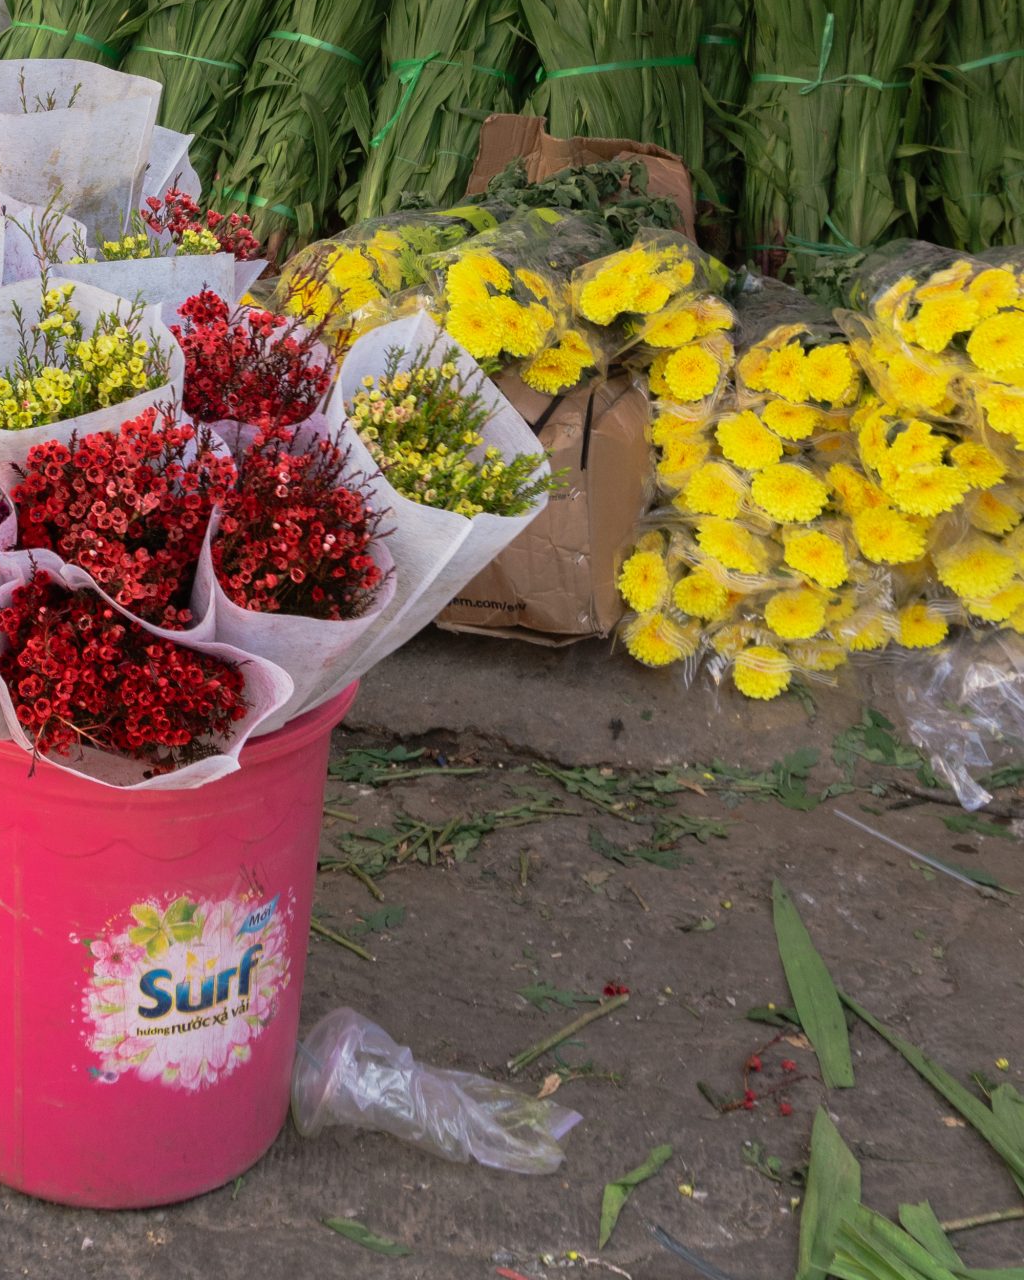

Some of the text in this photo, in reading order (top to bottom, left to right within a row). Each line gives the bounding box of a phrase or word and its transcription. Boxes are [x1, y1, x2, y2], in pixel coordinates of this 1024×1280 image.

[248, 904, 272, 927] Mới
[137, 943, 264, 1020] Surf
[171, 1011, 210, 1035] nước
[231, 1000, 250, 1019] vải
